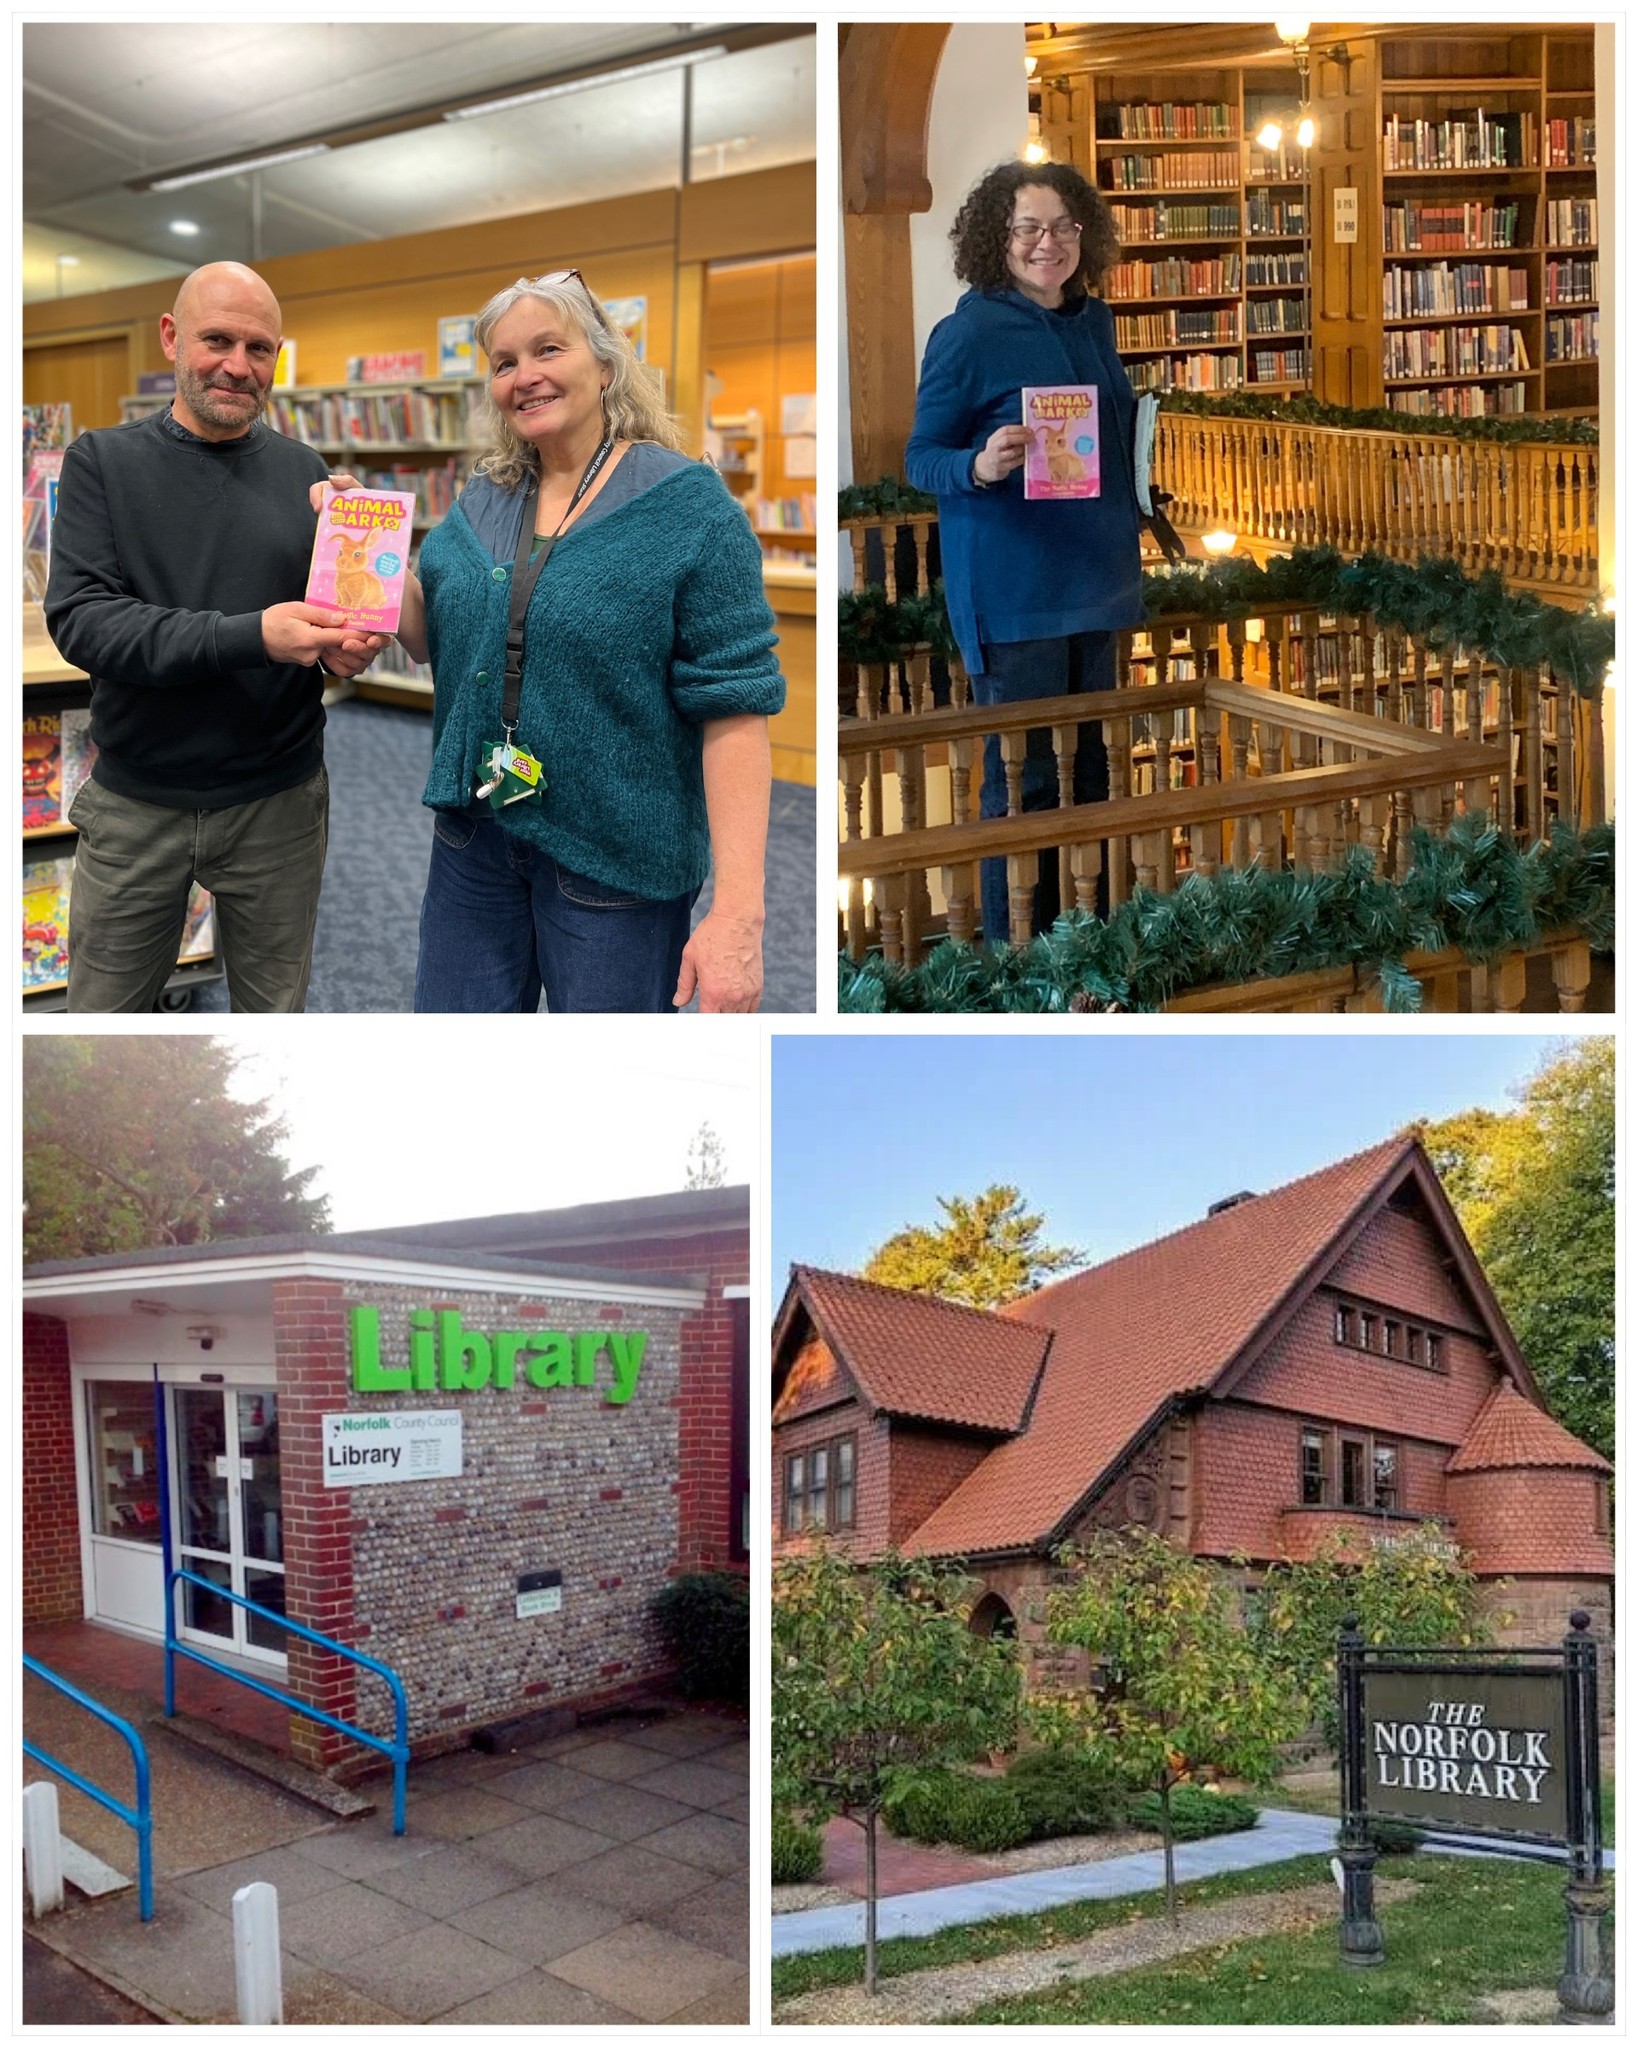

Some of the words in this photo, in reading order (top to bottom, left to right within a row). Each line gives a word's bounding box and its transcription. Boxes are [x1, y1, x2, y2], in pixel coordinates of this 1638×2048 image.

[584, 465, 598, 484] Library
[346, 513, 386, 528] ARK
[354, 1306, 648, 1405] Library
[342, 1416, 391, 1431] Norfolk
[394, 1416, 426, 1431] County
[427, 1414, 459, 1427] Council
[328, 1445, 402, 1468] Library
[1428, 1702, 1486, 1726] THE
[1373, 1721, 1552, 1768] NORFOLK
[1377, 1753, 1549, 1804] LIBRARY
